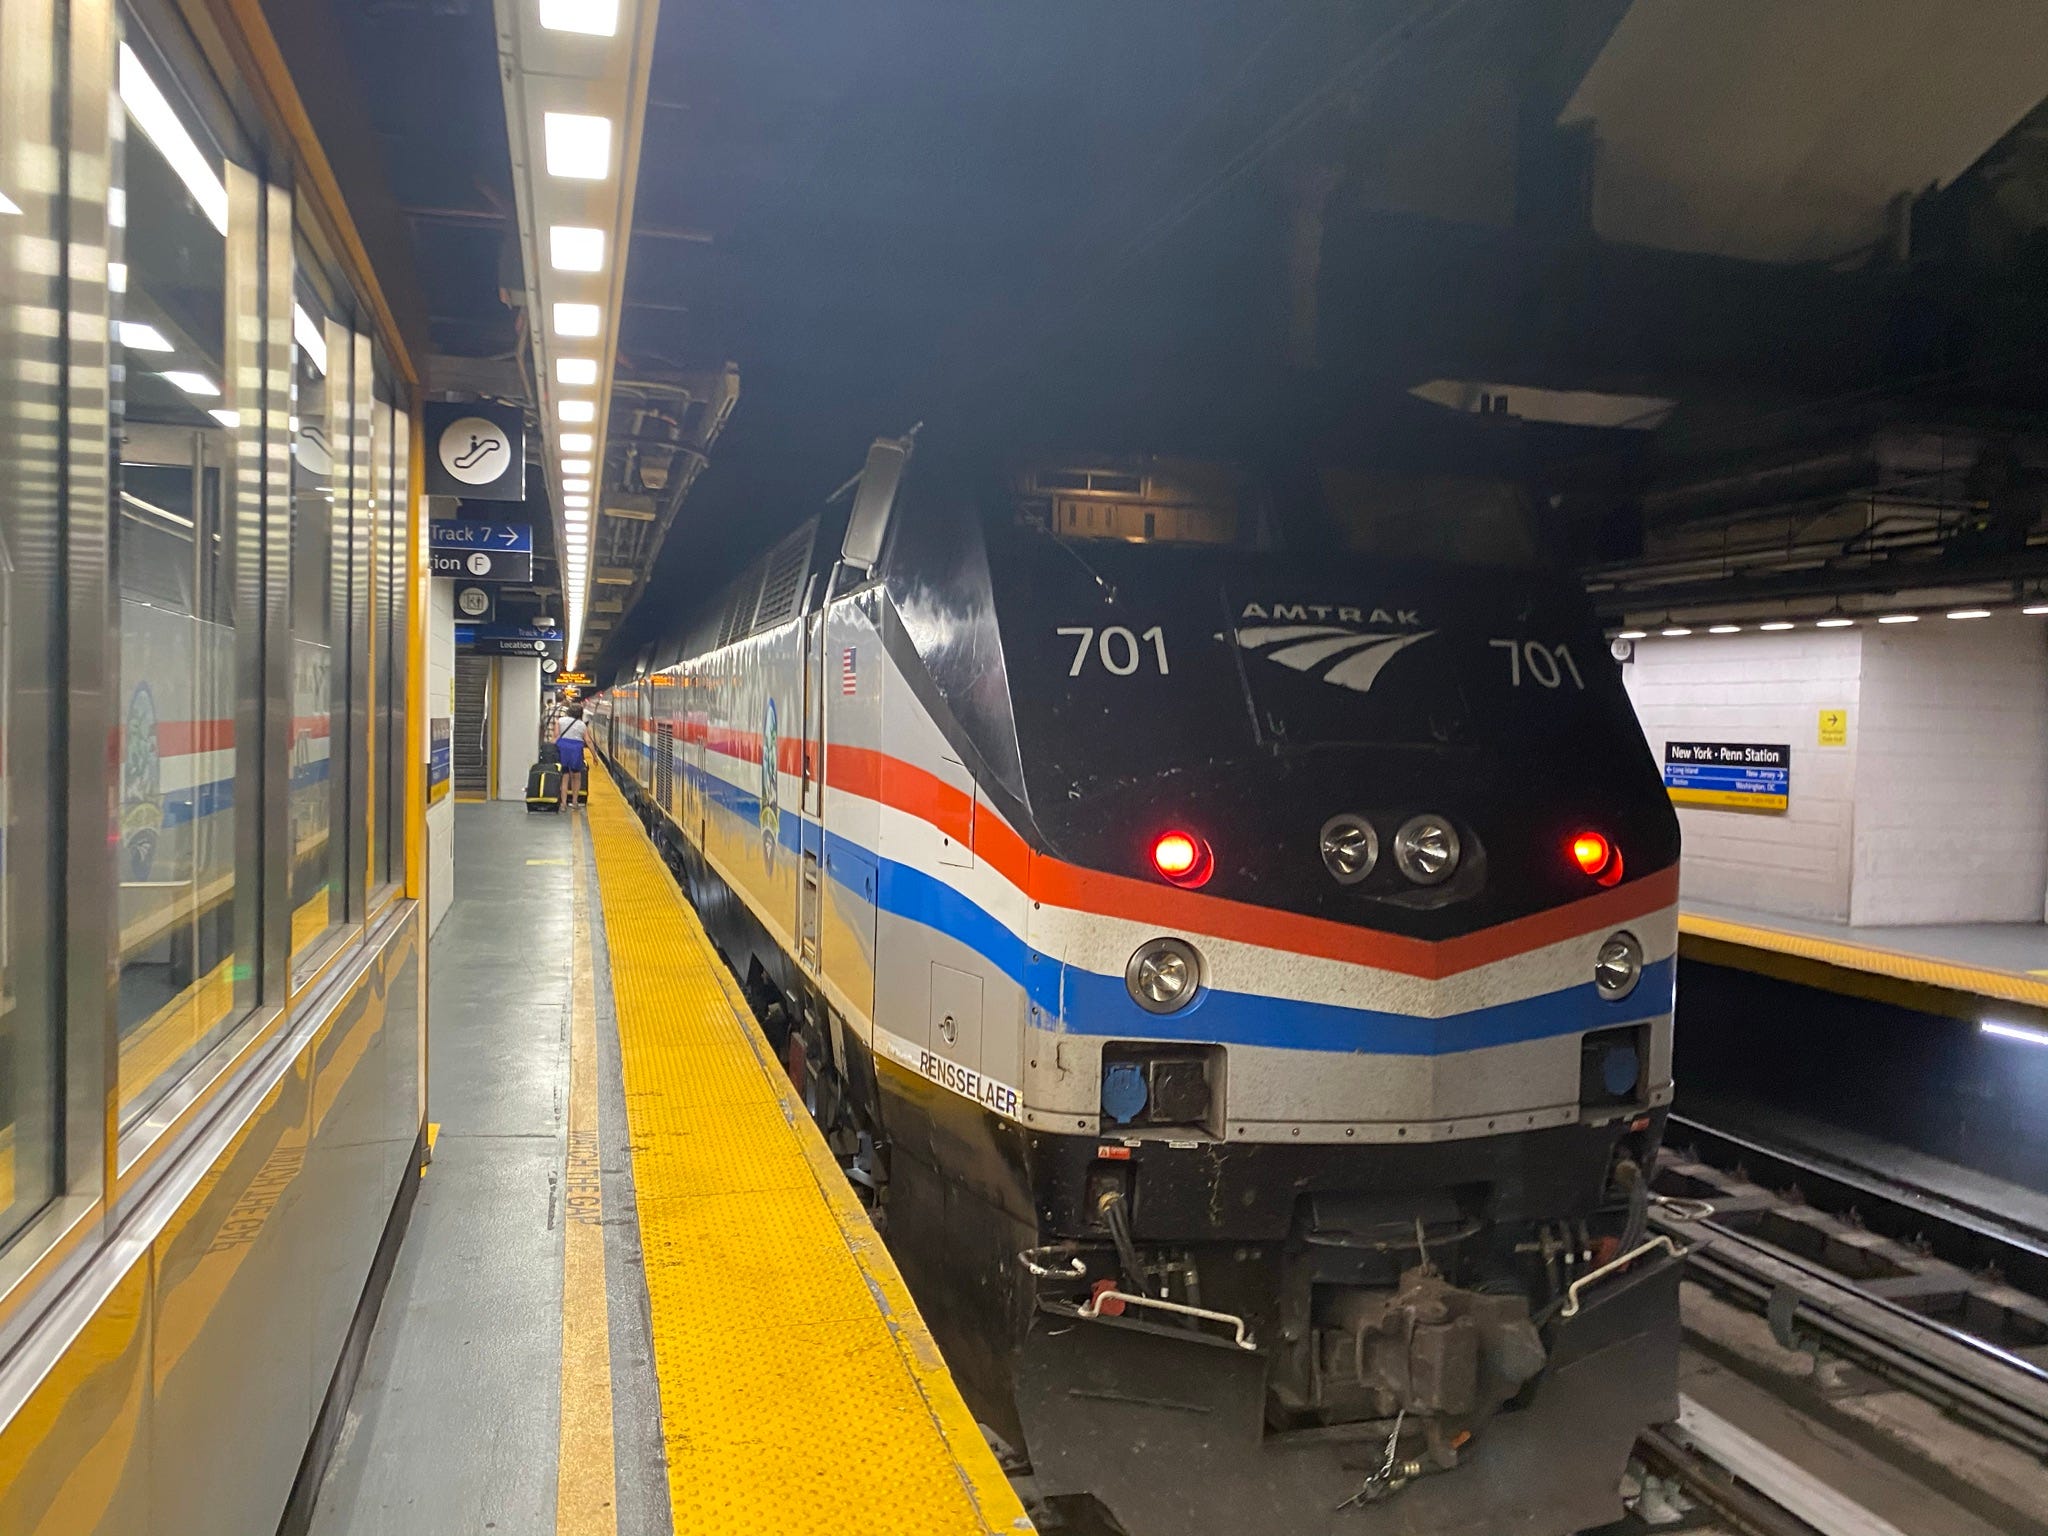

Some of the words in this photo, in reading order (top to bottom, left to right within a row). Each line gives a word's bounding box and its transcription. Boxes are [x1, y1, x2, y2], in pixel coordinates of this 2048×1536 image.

[430, 525, 474, 541] Track
[480, 527, 492, 542] 7
[474, 557, 484, 571] F
[1242, 602, 1421, 625] AMTRAK
[500, 641, 532, 649] Location
[1057, 625, 1170, 676] 701
[1489, 639, 1585, 690] 701
[1672, 746, 1690, 758] New
[1693, 747, 1712, 760] York
[1720, 748, 1743, 761] Penn
[1745, 749, 1779, 762] Station
[920, 1050, 1018, 1117] RENSSELAER
[568, 1129, 599, 1167] WATCH
[567, 1169, 599, 1193] THE
[566, 1196, 602, 1226] GAP
